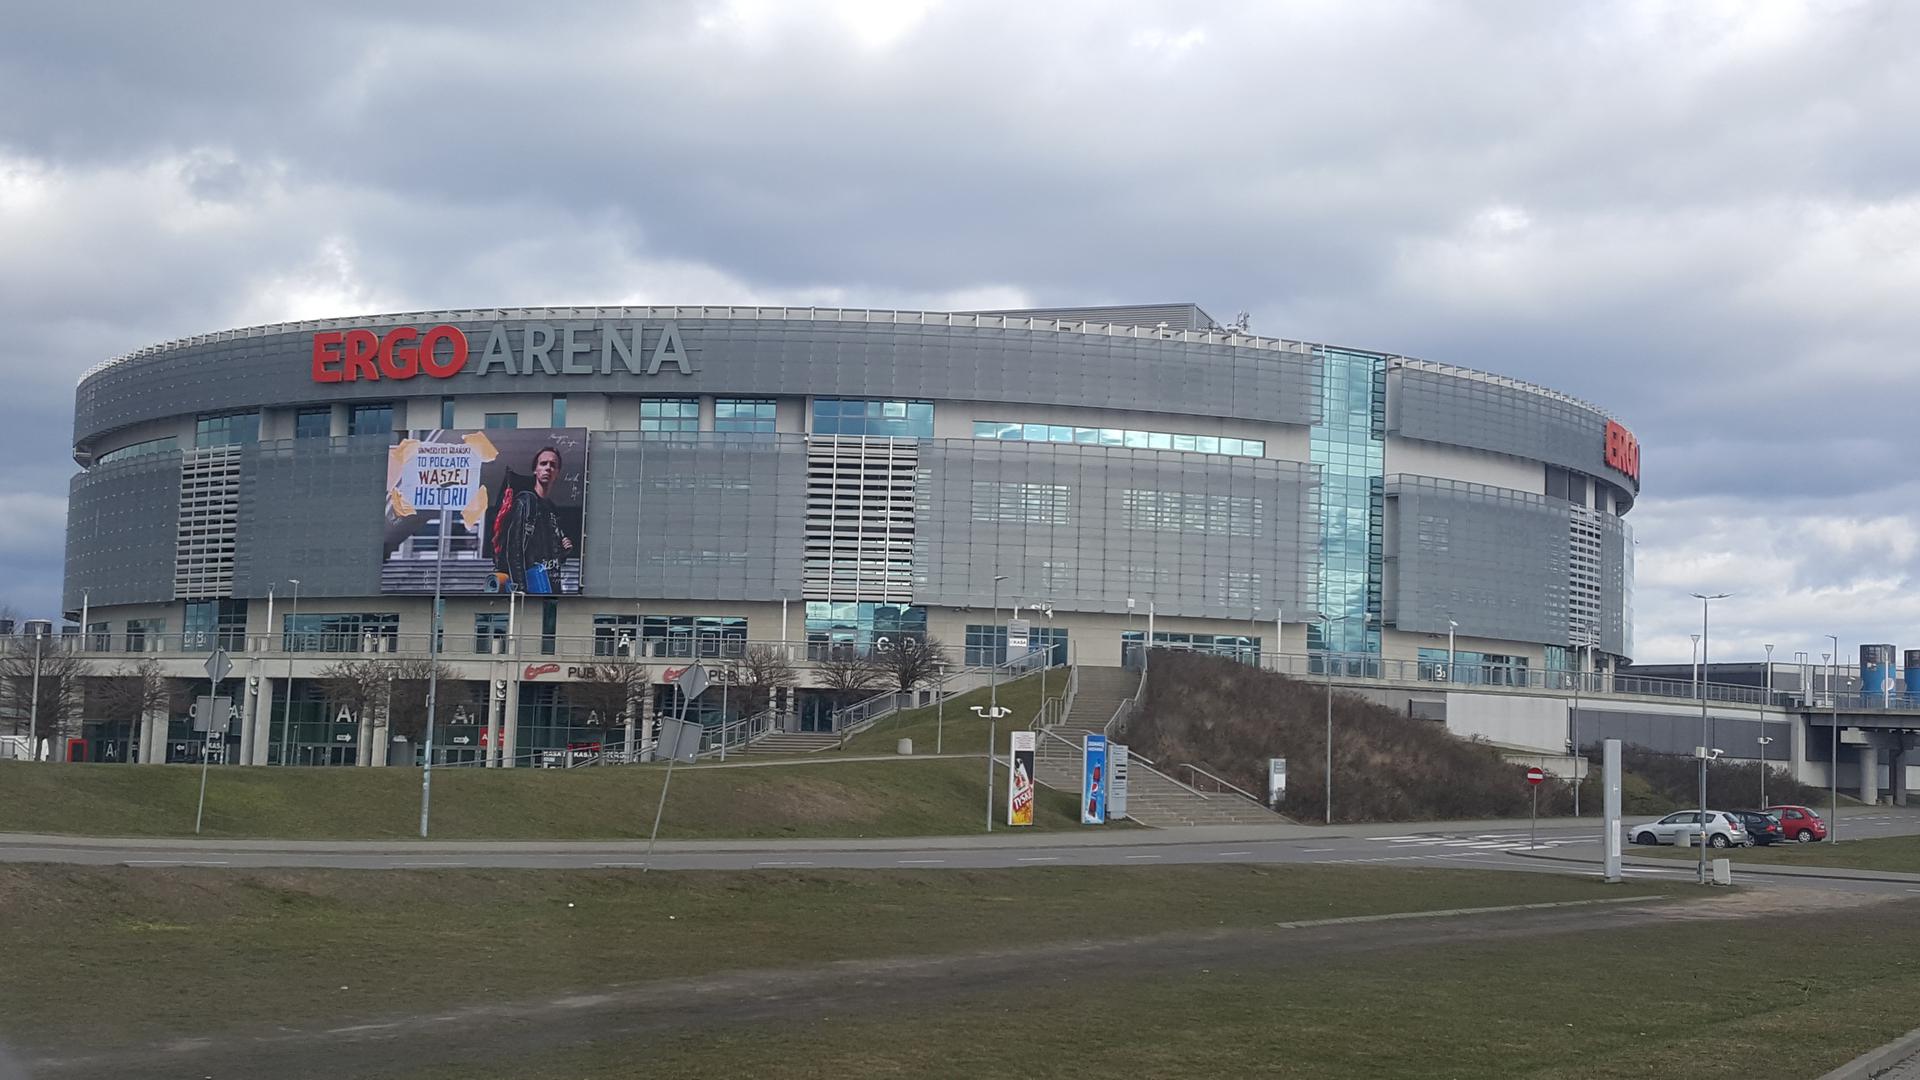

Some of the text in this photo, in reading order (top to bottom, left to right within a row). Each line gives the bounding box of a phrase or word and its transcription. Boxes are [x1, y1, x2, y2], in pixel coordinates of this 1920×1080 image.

[312, 321, 693, 383] ERGO ARENA
[1606, 420, 1640, 481] ERGO
[418, 456, 470, 469] TO POCZĄTEK
[419, 469, 470, 486] WASZEJ
[414, 487, 468, 506] HISTORII
[568, 666, 597, 679] PUB
[336, 703, 358, 723] A1
[451, 705, 475, 725] A1
